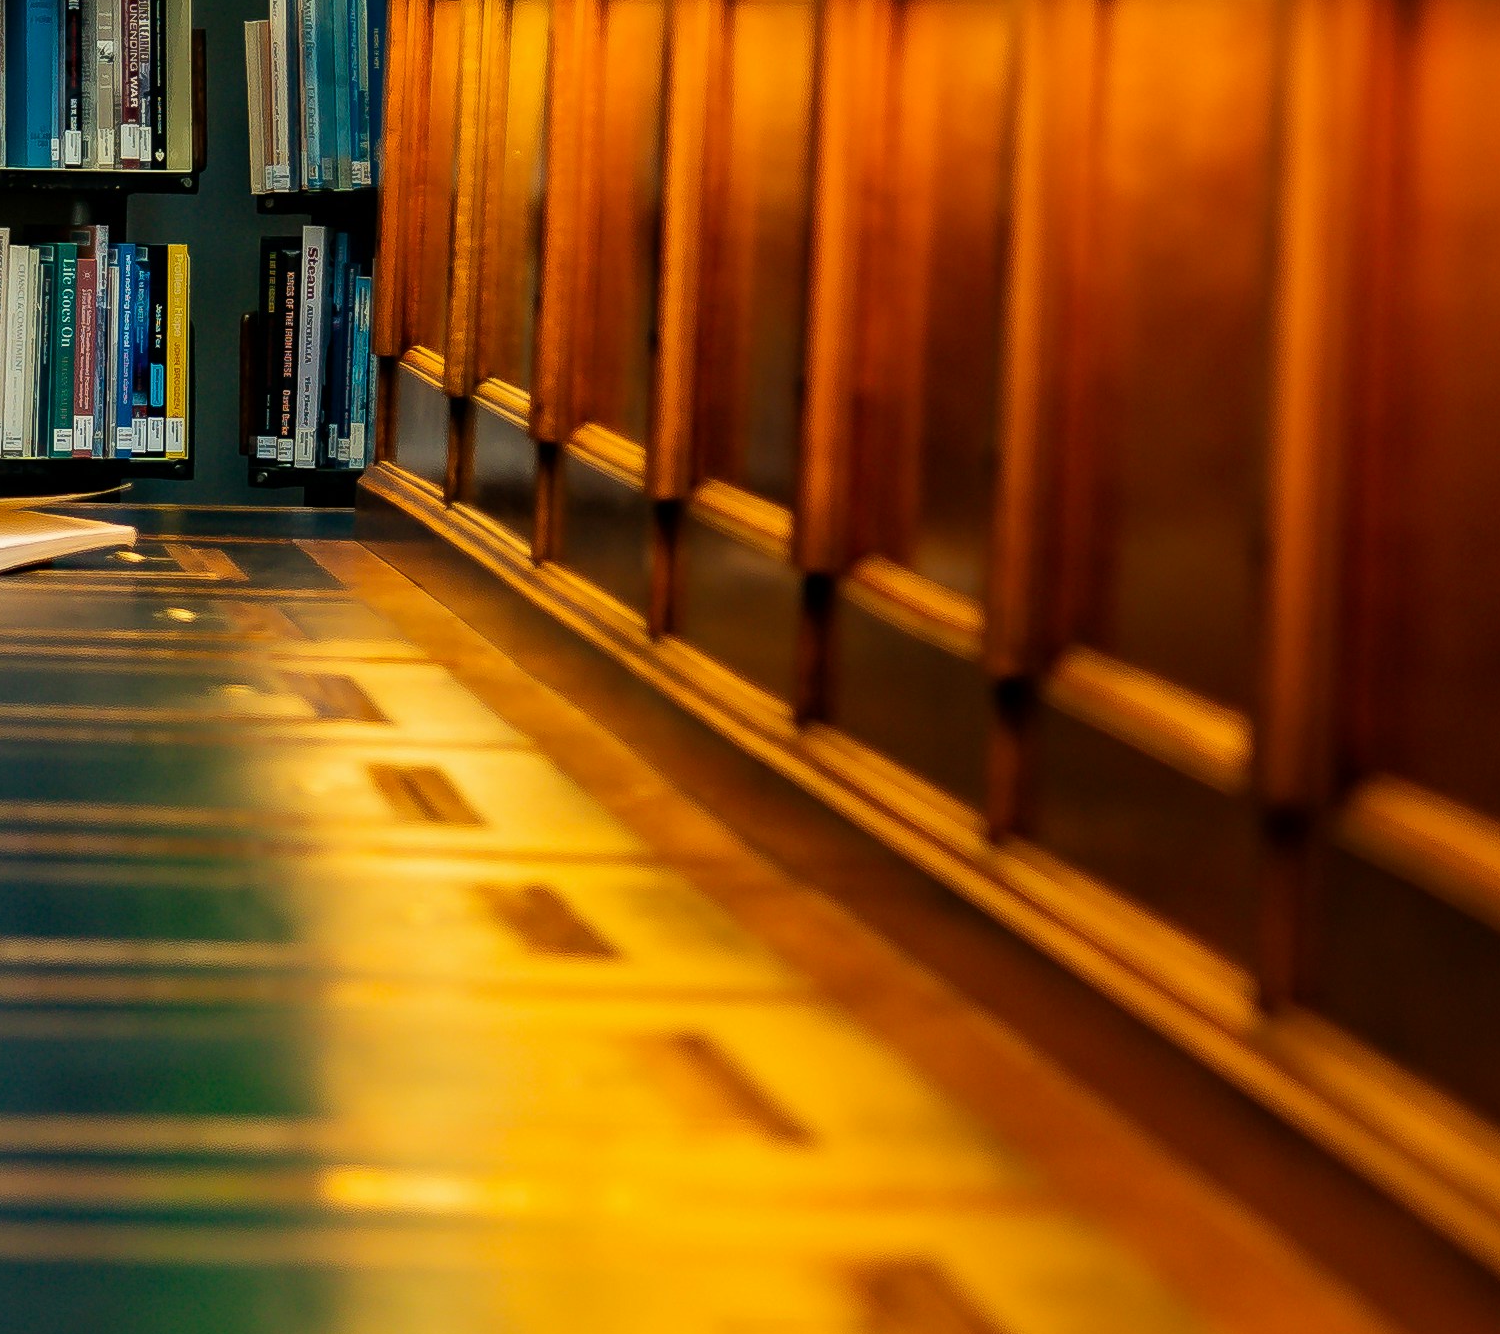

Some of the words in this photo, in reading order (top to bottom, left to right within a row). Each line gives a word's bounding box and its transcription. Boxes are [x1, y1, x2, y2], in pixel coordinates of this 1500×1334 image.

[129, 77, 138, 108] WAR
[61, 258, 76, 284] Life
[306, 247, 318, 300] Steam
[61, 288, 75, 322] Goes
[61, 327, 74, 347] On
